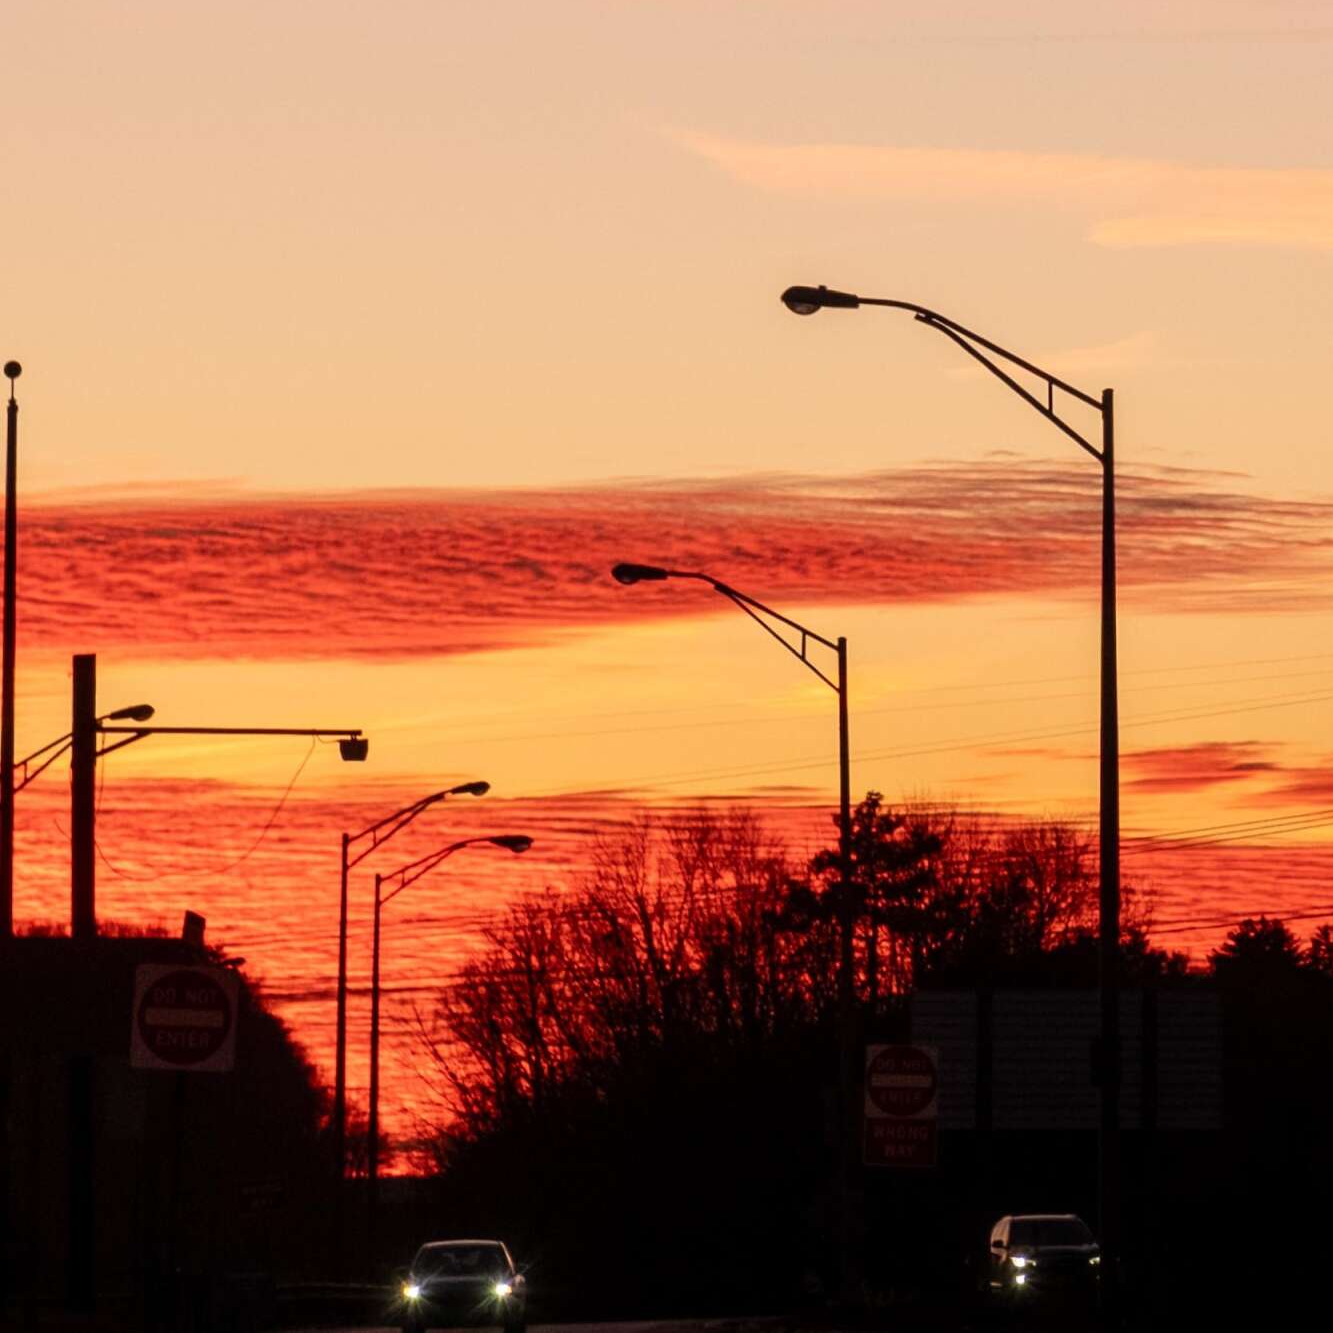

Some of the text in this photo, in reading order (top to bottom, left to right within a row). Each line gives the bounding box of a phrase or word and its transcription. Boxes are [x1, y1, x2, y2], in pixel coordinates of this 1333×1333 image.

[152, 987, 217, 1004] DO NOT
[157, 1030, 209, 1048] ENTER
[873, 1124, 929, 1141] WRONG
[884, 1143, 918, 1157] WAY
